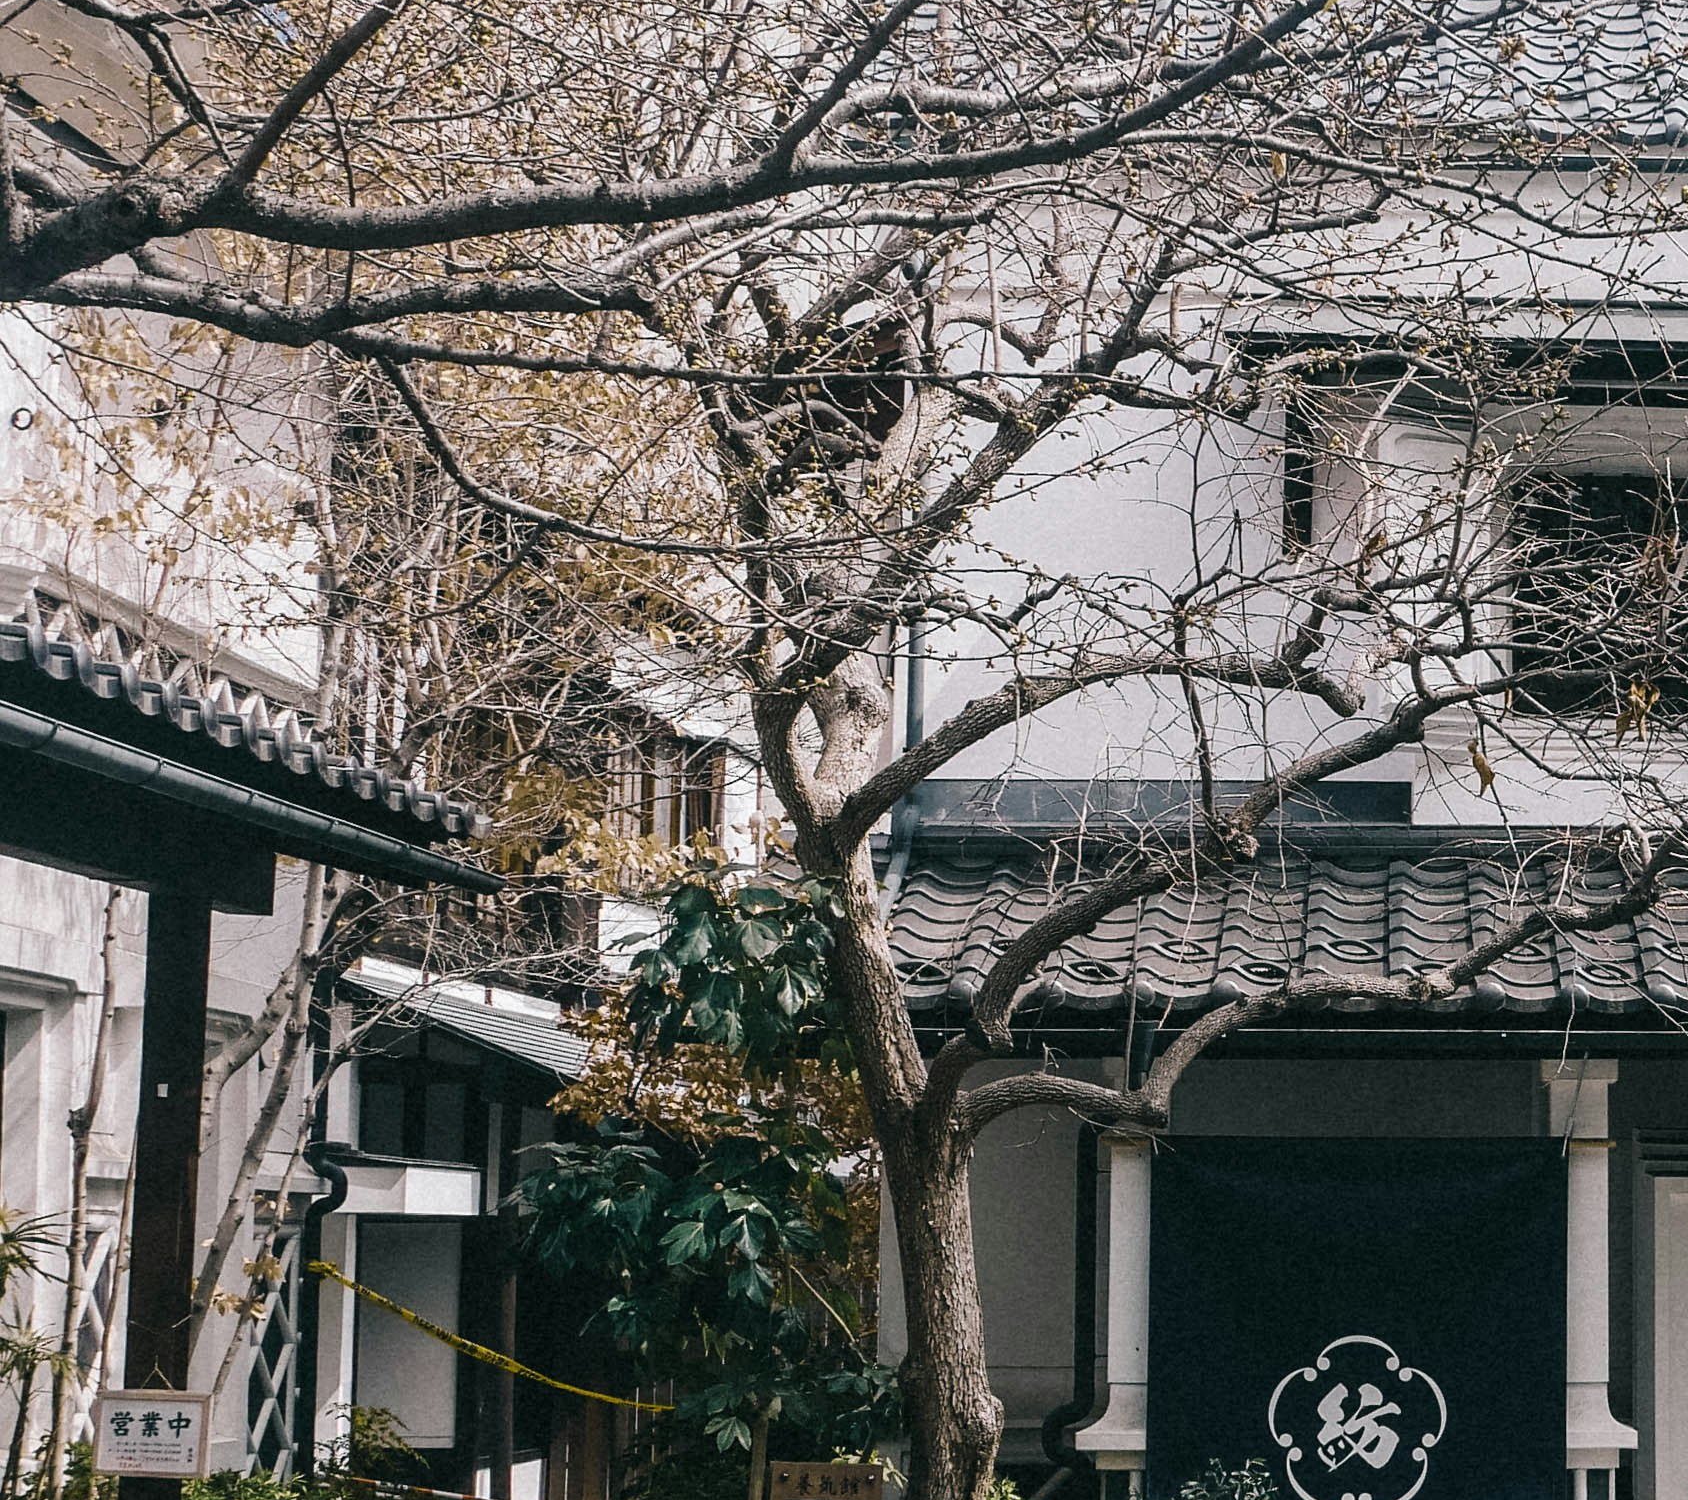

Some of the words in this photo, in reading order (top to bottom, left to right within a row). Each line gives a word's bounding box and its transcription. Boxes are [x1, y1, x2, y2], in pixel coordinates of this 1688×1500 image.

[110, 1411, 192, 1439] 営業中
[1317, 1382, 1401, 1472] 紡
